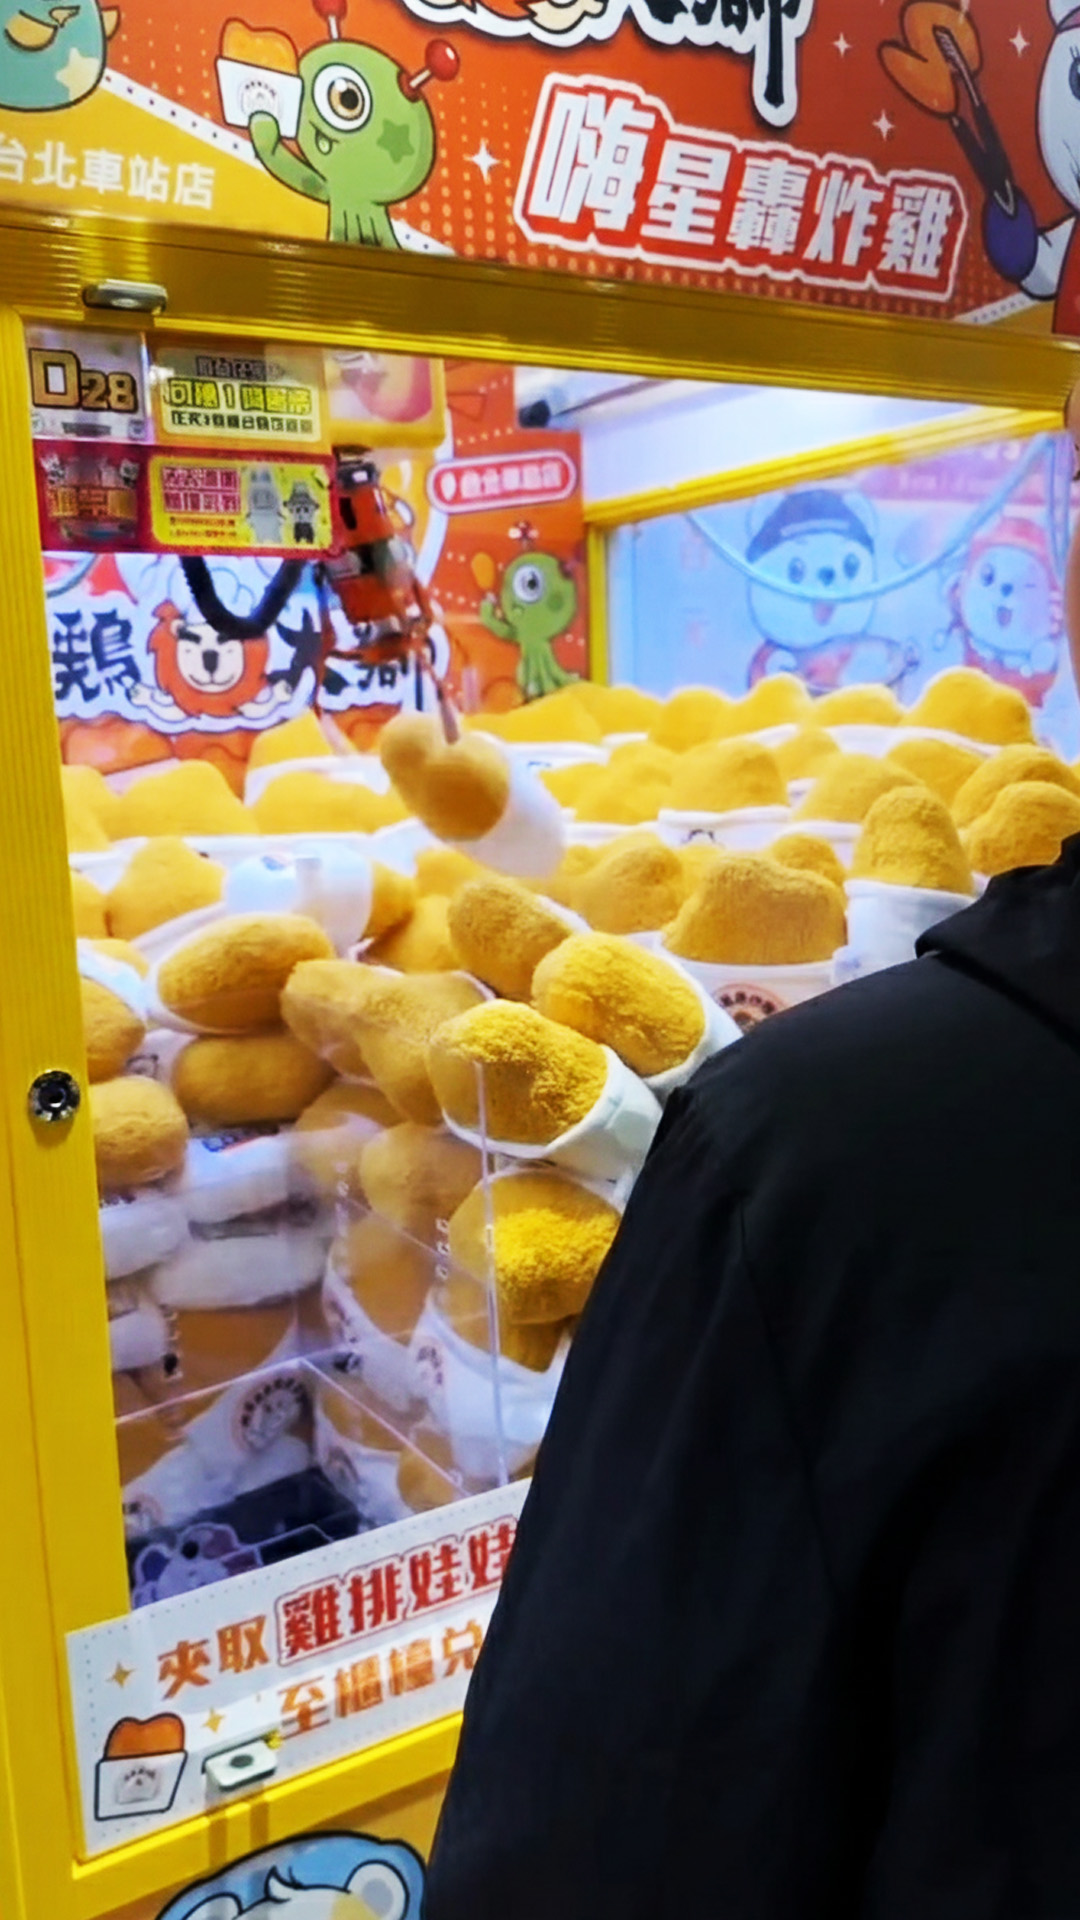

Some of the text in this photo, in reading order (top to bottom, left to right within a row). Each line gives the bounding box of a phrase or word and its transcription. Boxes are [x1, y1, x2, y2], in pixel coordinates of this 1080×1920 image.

[0, 135, 216, 209] 台北車站店
[528, 90, 951, 277] 嗨星轟炸雞
[29, 348, 138, 413] D28
